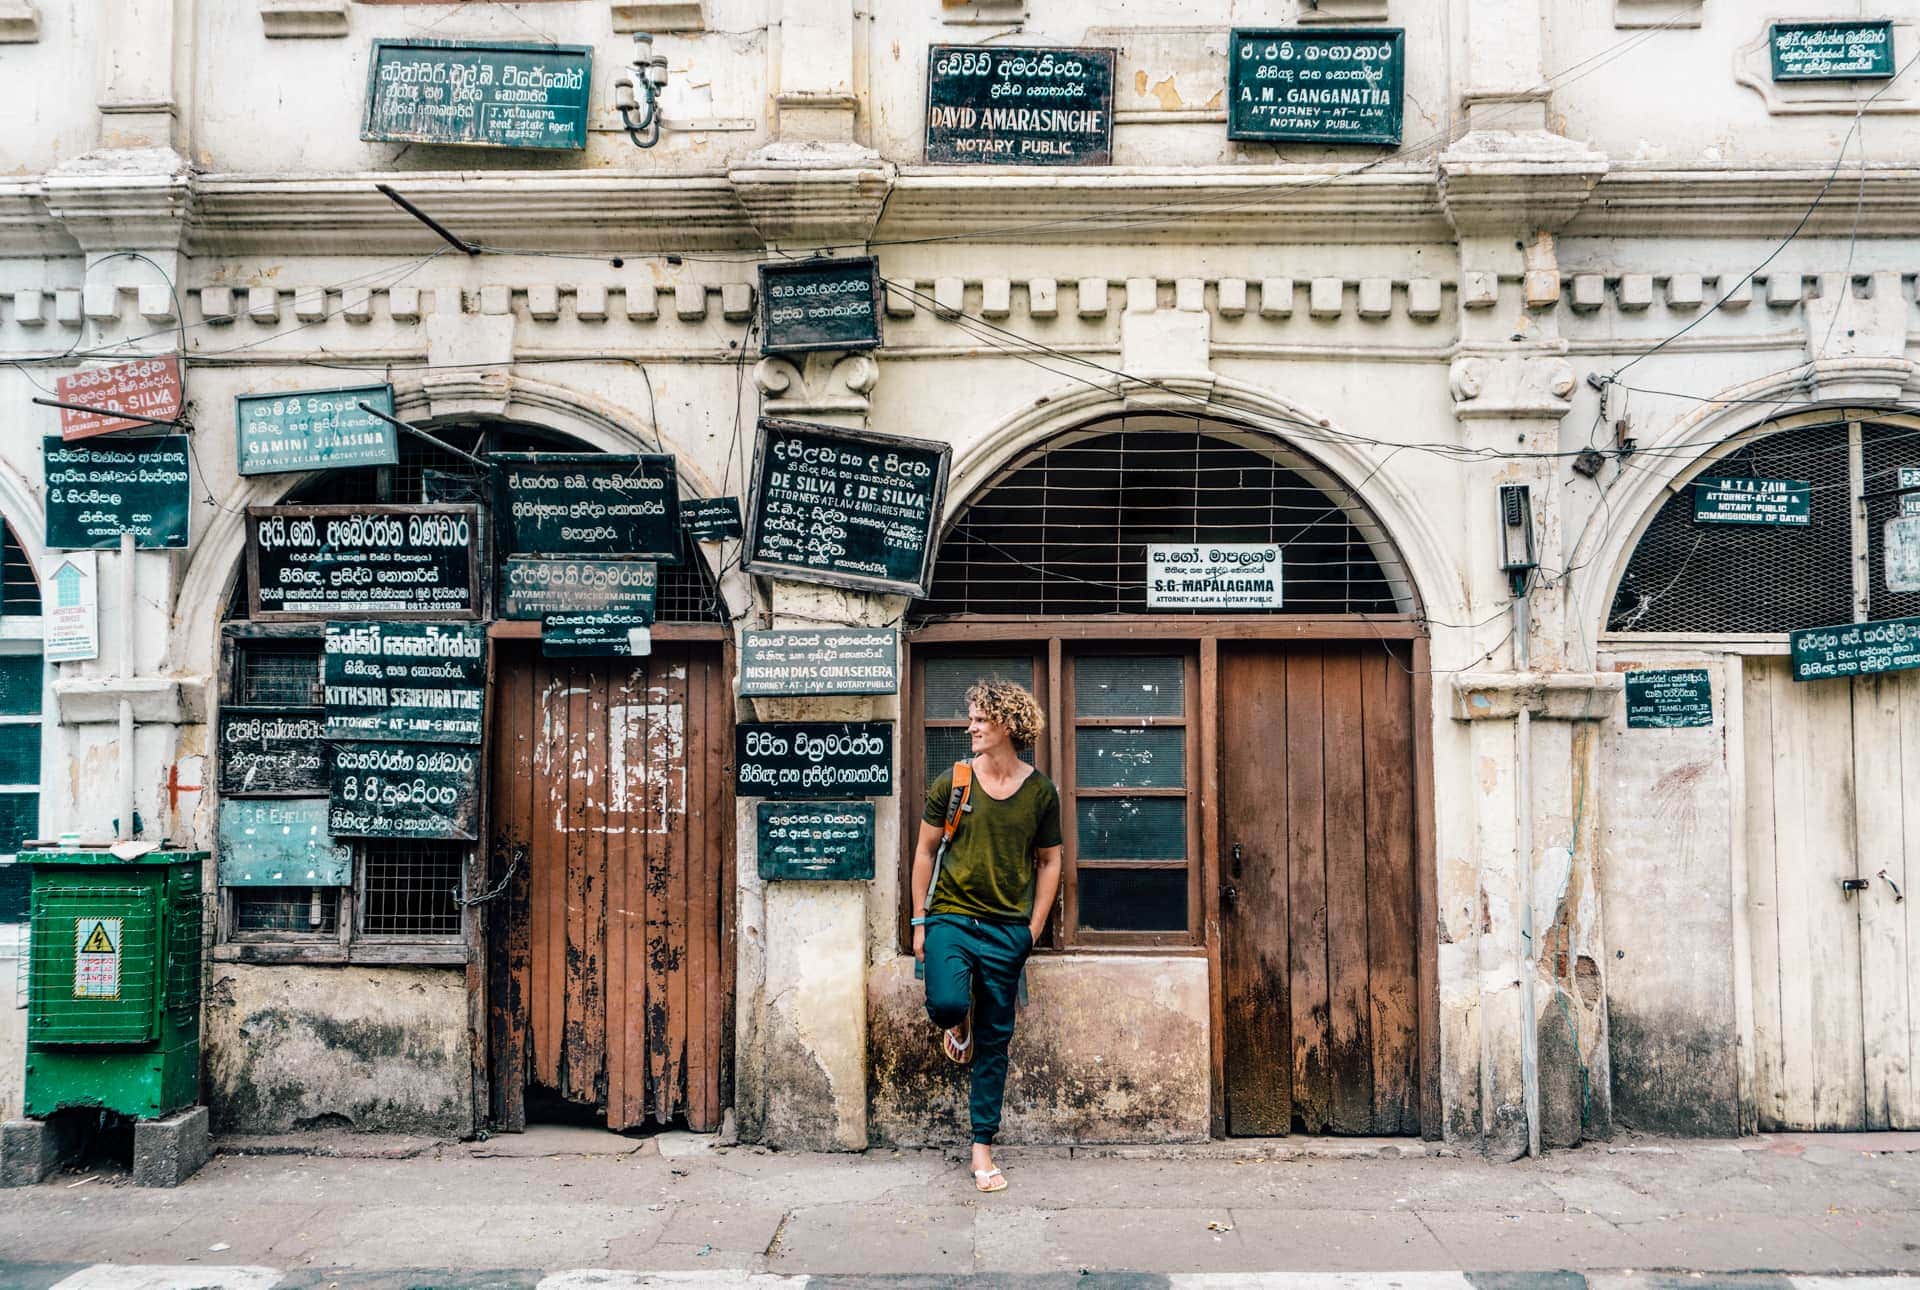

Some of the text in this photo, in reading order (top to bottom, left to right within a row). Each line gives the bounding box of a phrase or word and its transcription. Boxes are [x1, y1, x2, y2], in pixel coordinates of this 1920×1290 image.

[1286, 88, 1390, 105] GANGANATHA
[930, 107, 977, 128] DAVID
[1269, 117, 1361, 129] NOTARY PUBLIC
[955, 138, 1015, 153] NOTARY
[248, 437, 308, 454] GAMINI
[771, 472, 791, 489] DE
[796, 476, 836, 495] SILVA
[858, 485, 878, 501] DE
[882, 489, 925, 508] SILVA
[1718, 503, 1787, 513] NOTARY PUBLIC
[1697, 512, 1808, 523] COMMISSIONER OF OATHS
[1209, 549, 1276, 566] මාපලගම
[376, 566, 439, 583] නොතාරිස්
[1155, 579, 1274, 592] S.G. MAPALAGAMA
[746, 666, 893, 678] NISHAN DIAS GUNASEKERA
[325, 686, 388, 706] KITHSIRI
[780, 770, 801, 783] සහ
